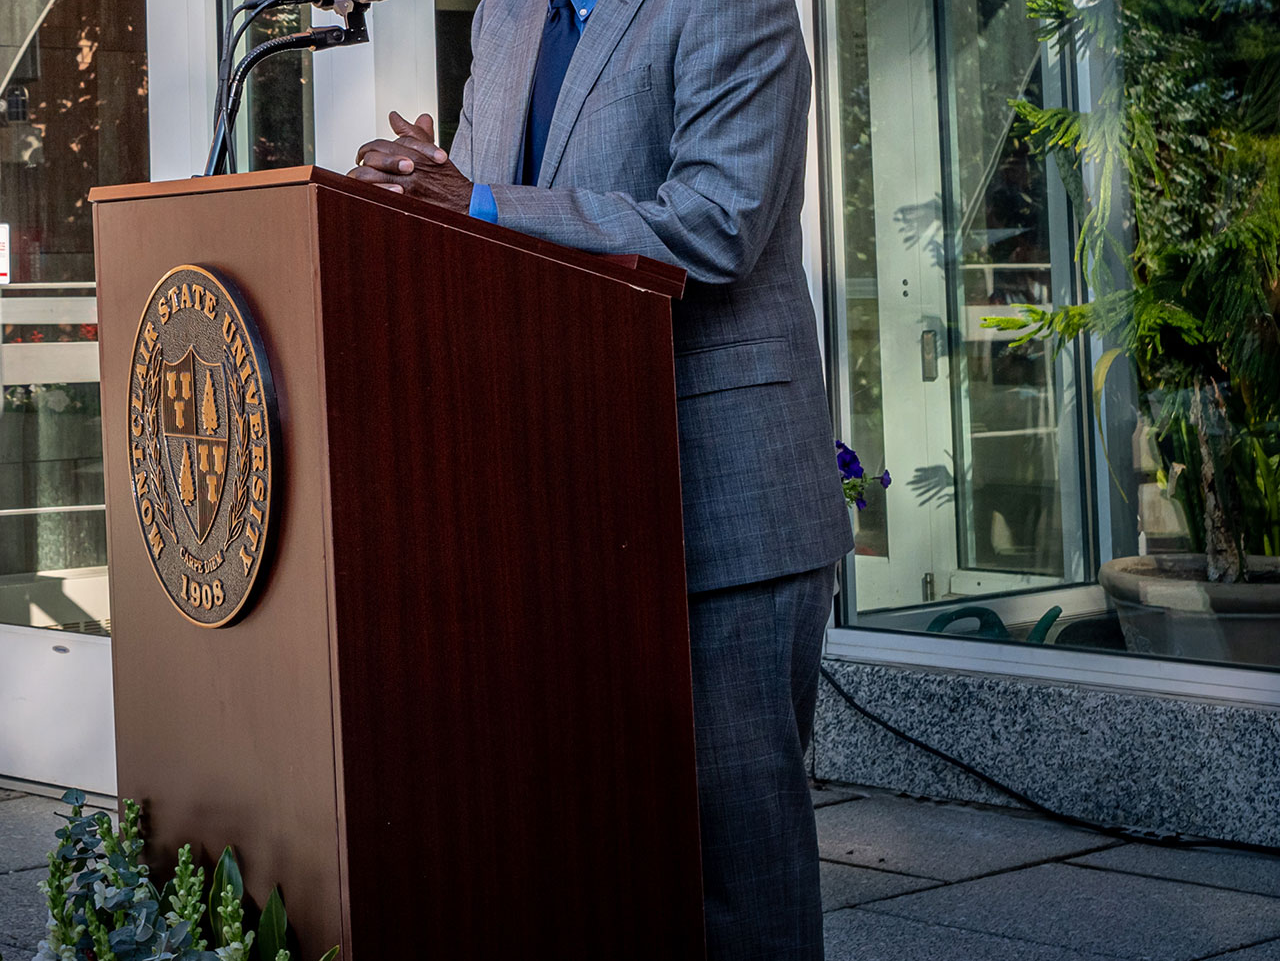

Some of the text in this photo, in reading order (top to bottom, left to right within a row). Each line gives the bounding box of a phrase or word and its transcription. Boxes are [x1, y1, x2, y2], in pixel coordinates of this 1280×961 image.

[133, 283, 266, 577] MONTCLAIR STATE UNIVERSITY
[180, 547, 224, 574] CARPE DIEM
[181, 574, 224, 610] 1908
